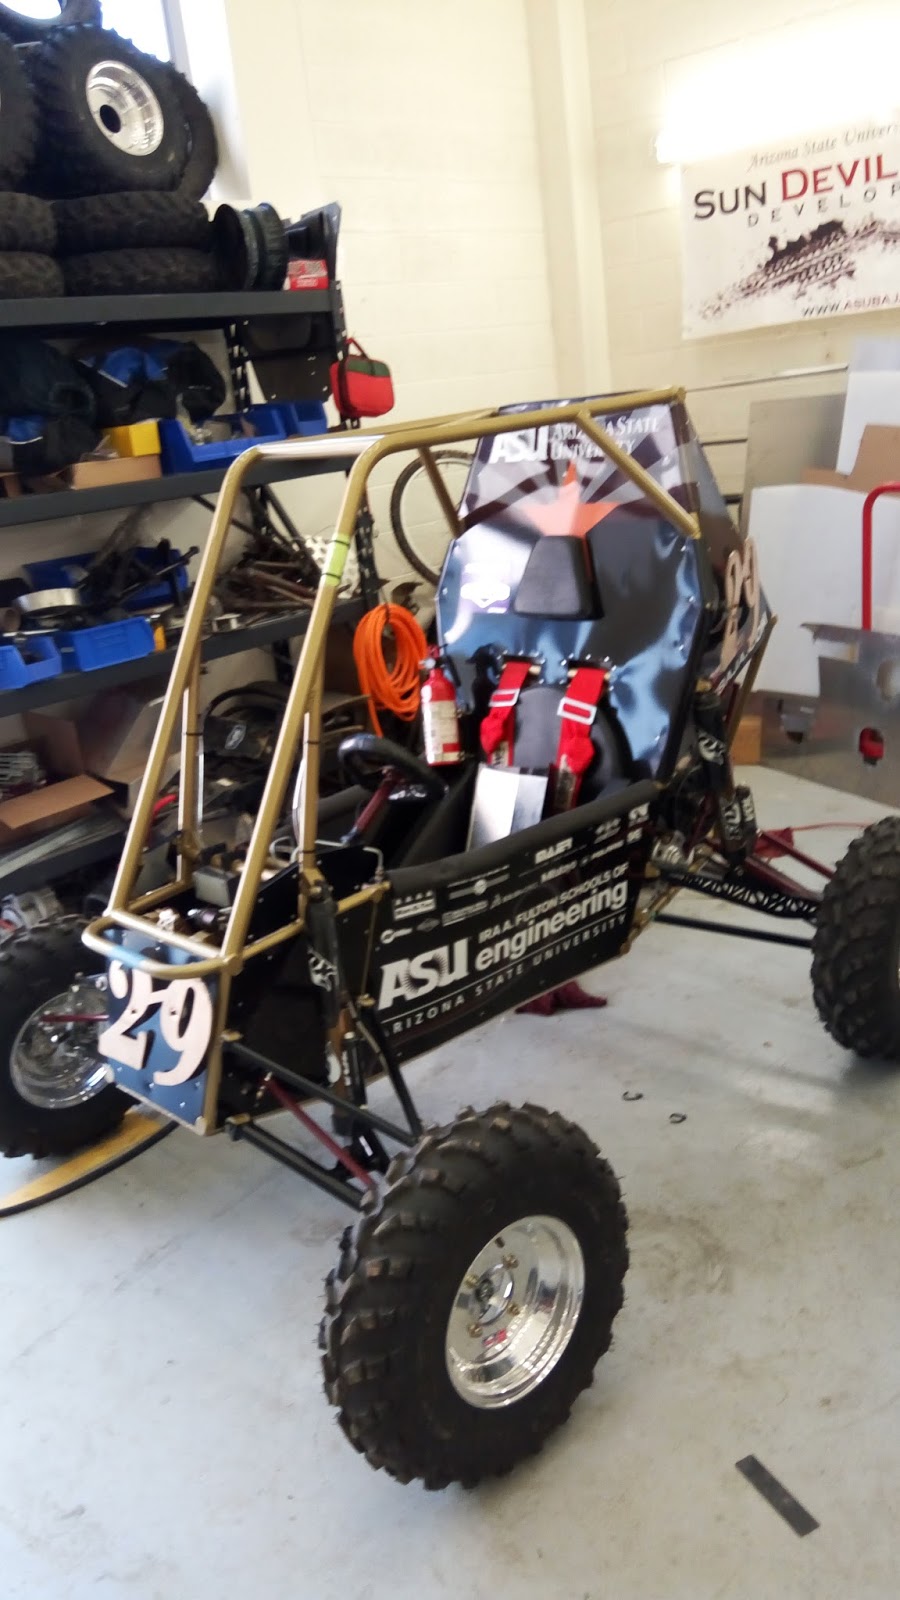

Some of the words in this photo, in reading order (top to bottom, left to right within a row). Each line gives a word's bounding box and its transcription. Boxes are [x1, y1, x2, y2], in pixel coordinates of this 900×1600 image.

[804, 137, 837, 158] State
[693, 181, 767, 220] SUN
[781, 154, 898, 202] DEVIL
[489, 424, 549, 465] ASU
[515, 896, 558, 927] FULTON
[559, 870, 612, 905] SCHOOLS
[612, 861, 629, 879] OF
[378, 937, 469, 1011] ASU
[475, 879, 628, 971] engineering
[475, 962, 524, 996] STATE
[532, 913, 627, 966] UNIVERSITY
[97, 959, 213, 1087] 29
